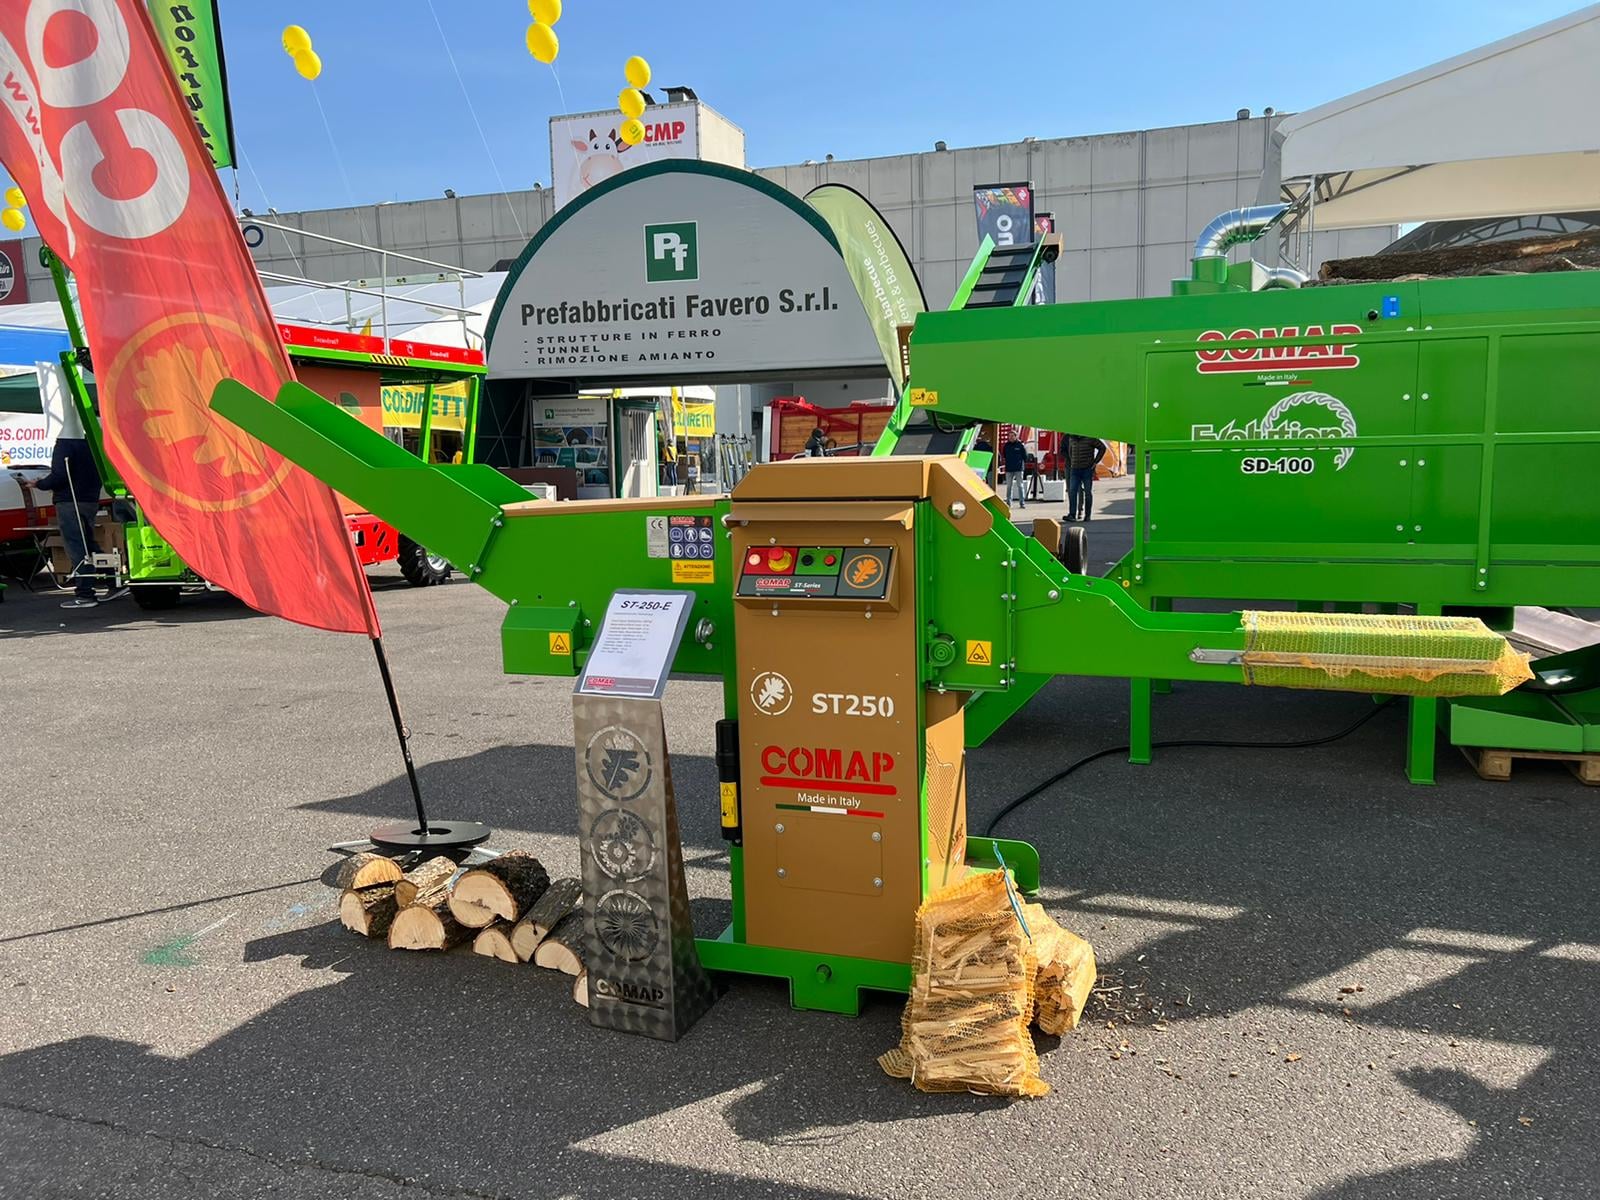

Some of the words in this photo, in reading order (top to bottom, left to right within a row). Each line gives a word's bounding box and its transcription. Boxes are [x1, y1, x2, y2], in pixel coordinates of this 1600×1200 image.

[865, 220, 897, 285] Barbecues
[863, 257, 894, 320] barbecue
[891, 285, 901, 296] &
[521, 297, 675, 326] Prefabbricati
[687, 294, 769, 320] Favero
[779, 287, 838, 312] S.r.l.
[897, 297, 912, 323] ens
[537, 332, 633, 345] STRUTTURE
[642, 331, 658, 341] IN
[668, 328, 722, 339] FERRO
[1195, 324, 1363, 362] COMAP
[537, 345, 600, 355] TUNNEL
[538, 354, 629, 365] RIMOZIONE
[638, 350, 715, 362] AMIANTO
[1241, 457, 1314, 474] SD-100
[621, 600, 672, 611] ST-250-E
[812, 693, 894, 718] ST250
[761, 745, 894, 782] COMAP
[797, 792, 825, 804] Made
[827, 795, 837, 804] in
[839, 796, 861, 808] Italy
[596, 979, 665, 1002] COMAP
